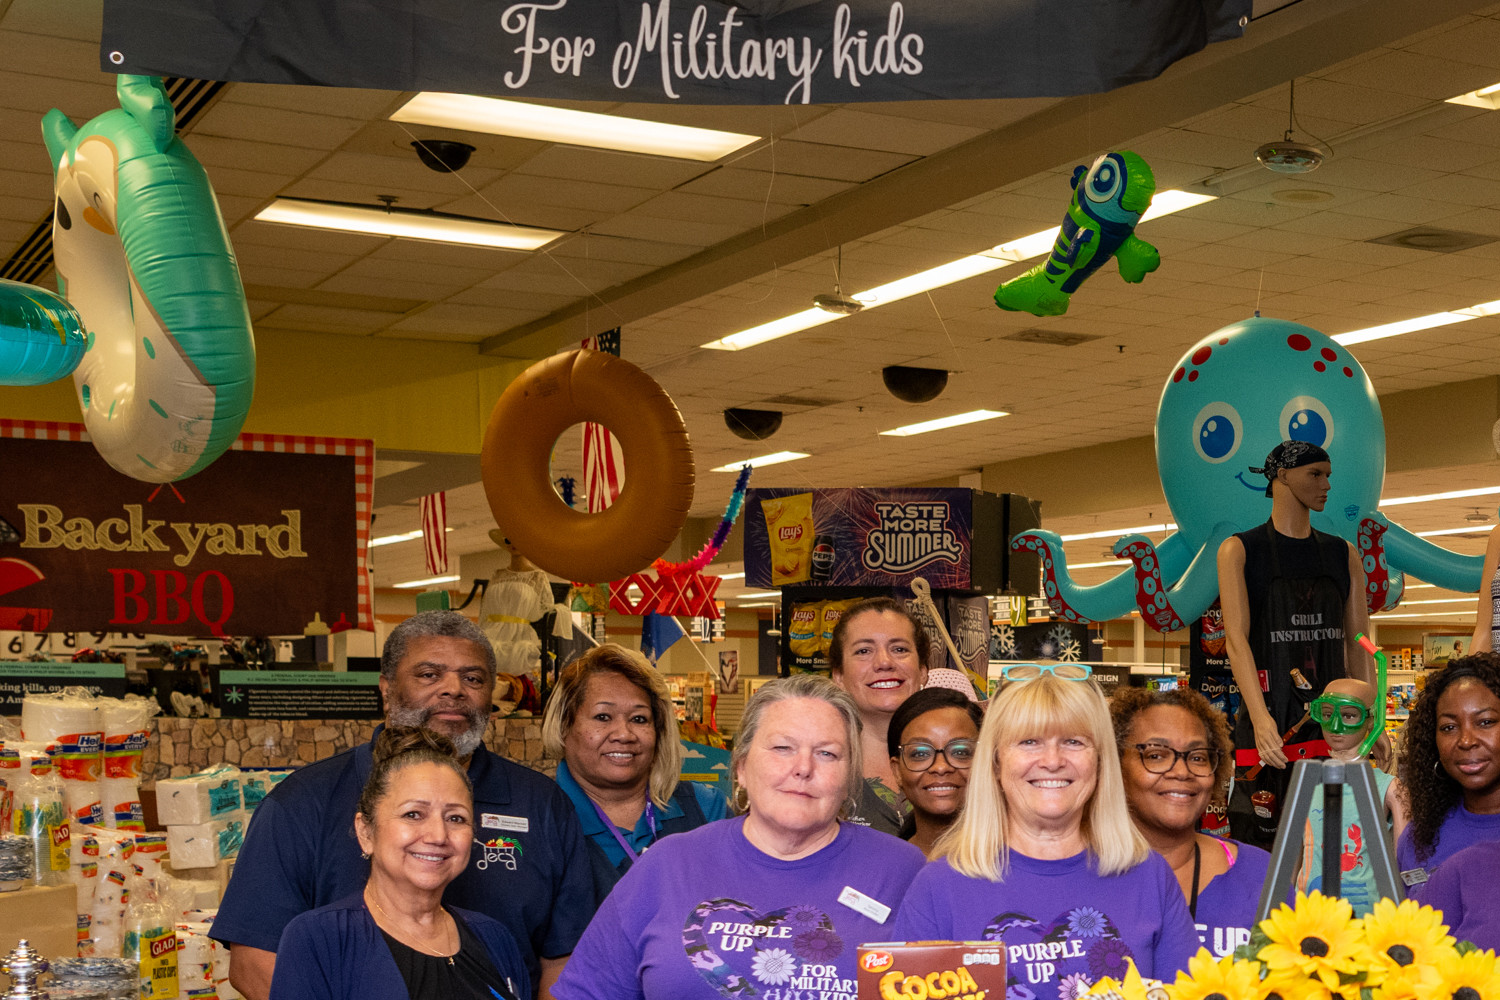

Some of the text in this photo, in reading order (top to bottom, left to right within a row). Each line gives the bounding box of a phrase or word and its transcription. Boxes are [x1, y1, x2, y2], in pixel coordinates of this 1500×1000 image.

[500, 0, 924, 104] For Military kids
[877, 505, 946, 519] TASTE
[883, 518, 942, 532] MORE
[18, 503, 308, 567] Backyard
[812, 551, 835, 561] PEPSI
[864, 531, 963, 570] SUMMER
[107, 568, 235, 637] BBQ
[8, 636, 23, 653] 6
[34, 633, 49, 651] 7
[63, 632, 76, 647] 8
[1206, 658, 1223, 666] More
[1091, 674, 1120, 683] REIGN
[708, 921, 793, 939] PURPLE
[152, 937, 175, 956] GLAD
[719, 935, 754, 952] UP
[1213, 926, 1251, 957] UP
[865, 952, 889, 969] Post
[1009, 939, 1087, 964] PURPLE
[801, 963, 838, 979] FOR
[1025, 961, 1056, 984] UP
